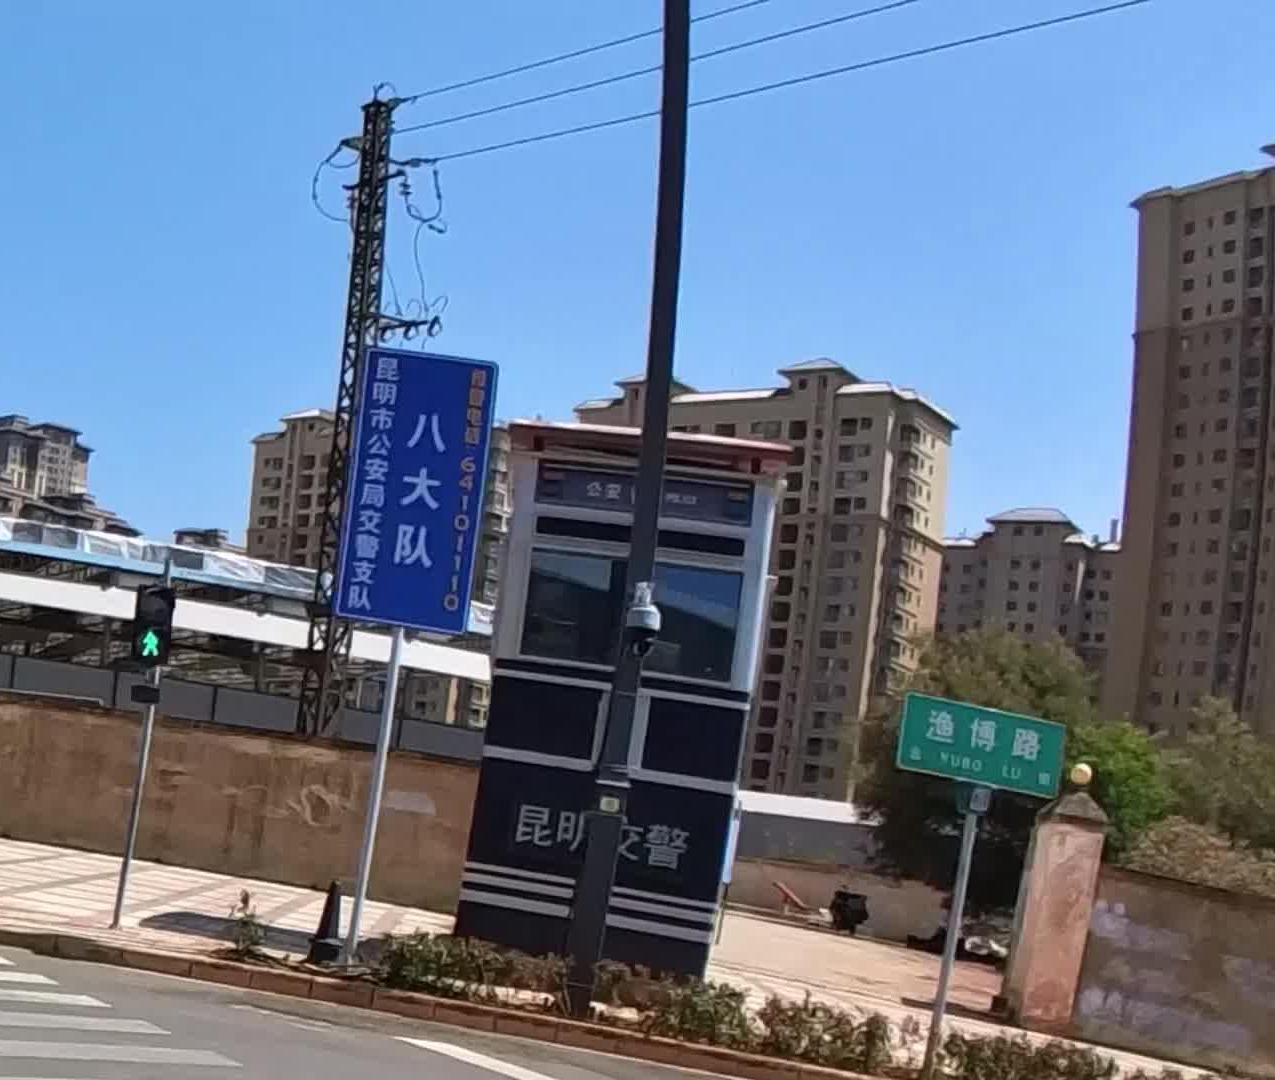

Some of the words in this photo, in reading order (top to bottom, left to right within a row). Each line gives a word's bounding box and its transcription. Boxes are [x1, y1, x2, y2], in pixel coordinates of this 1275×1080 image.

[348, 357, 400, 611] 昆明市公安局交警支队
[394, 413, 446, 569] 八大队
[926, 710, 1040, 761] 渔博路
[940, 753, 982, 772] YUBO
[1002, 761, 1021, 779] LU
